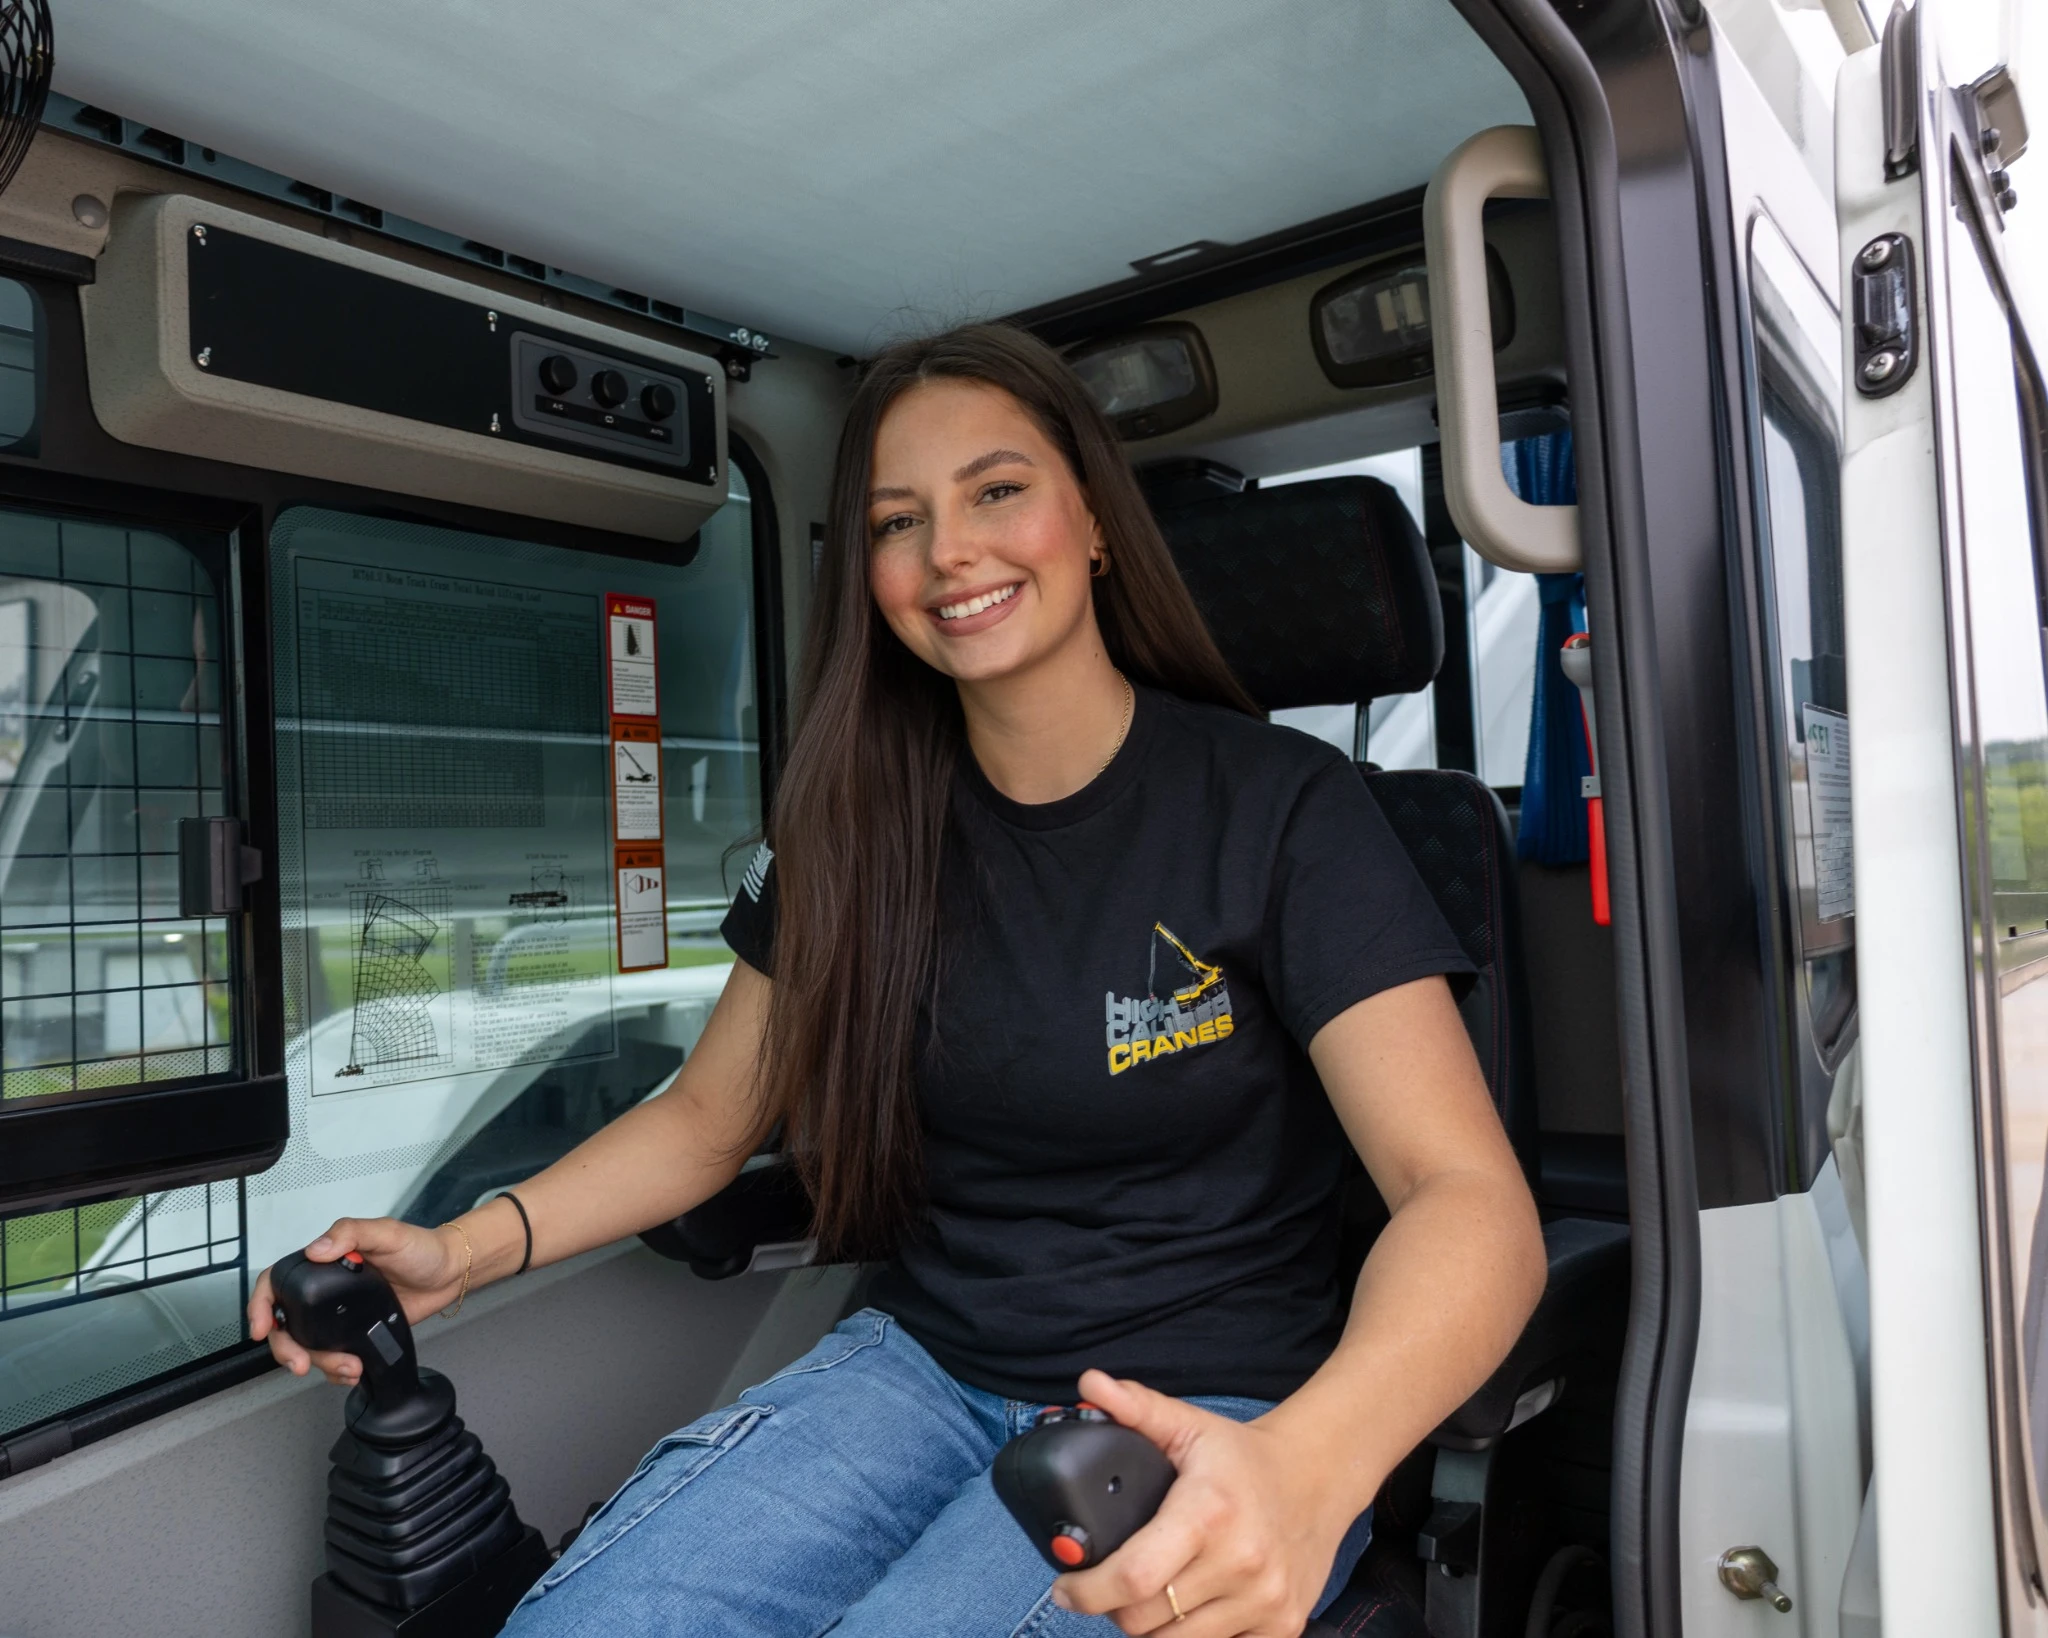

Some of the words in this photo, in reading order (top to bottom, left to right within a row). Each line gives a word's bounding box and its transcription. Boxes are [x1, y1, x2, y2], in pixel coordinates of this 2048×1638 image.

[552, 403, 563, 411] A/C
[406, 575, 426, 589] Truck
[624, 604, 652, 617] DANGER
[1105, 991, 1180, 1024] HIGH
[1106, 990, 1233, 1048] CALIBER
[1108, 1014, 1235, 1076] CRANES
